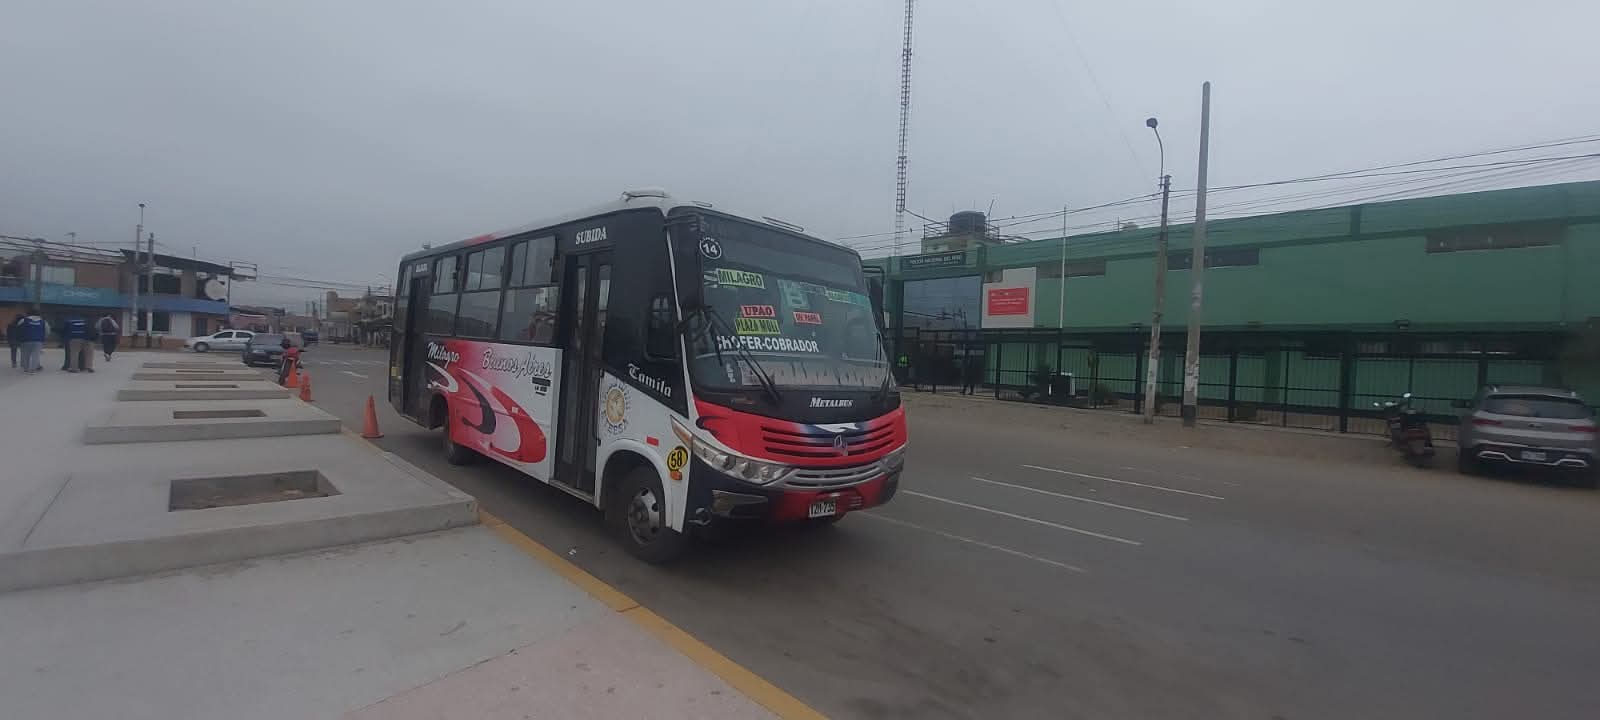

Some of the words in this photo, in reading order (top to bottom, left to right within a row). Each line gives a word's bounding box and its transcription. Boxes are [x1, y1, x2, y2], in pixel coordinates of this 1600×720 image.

[576, 226, 607, 244] SUBIDA
[703, 242, 718, 255] 14
[719, 270, 763, 287] MILAGRO
[743, 305, 773, 317] UPAO
[427, 341, 460, 369] Milagro
[670, 452, 684, 468] 58
